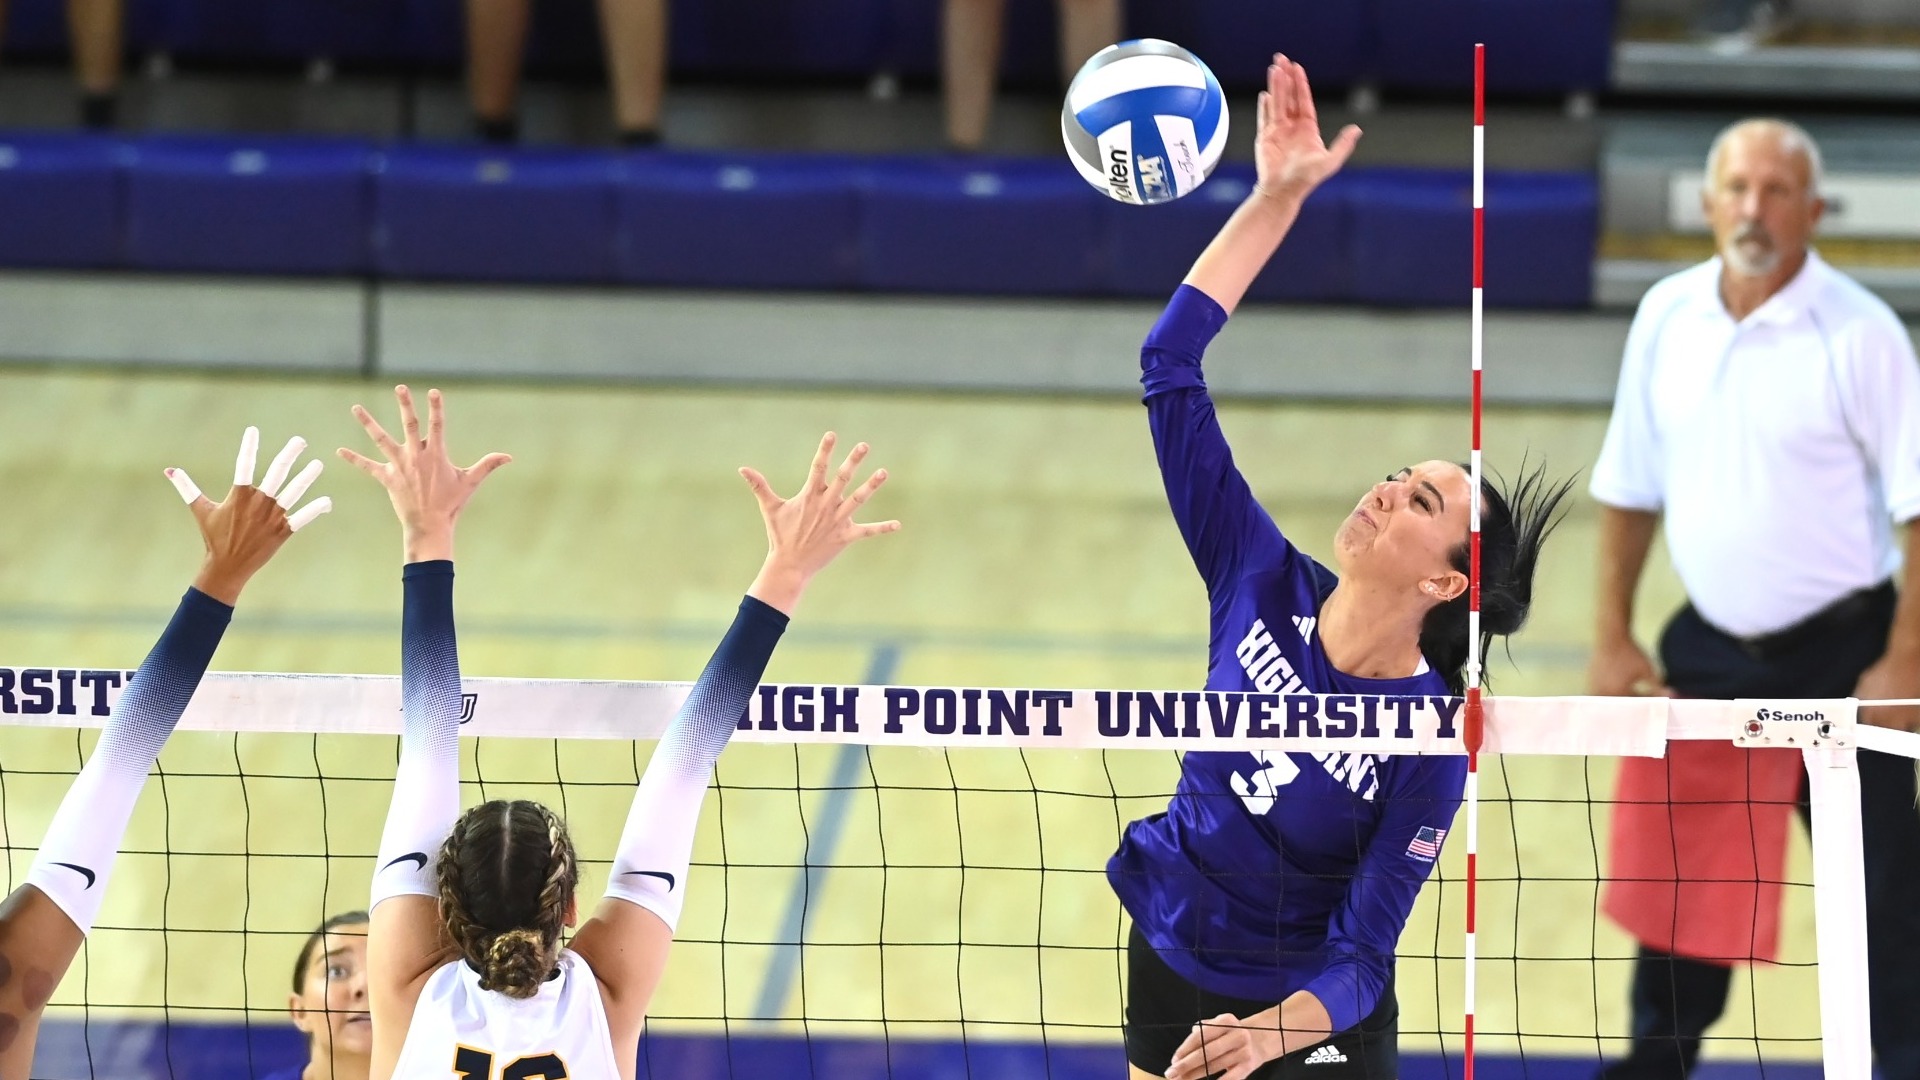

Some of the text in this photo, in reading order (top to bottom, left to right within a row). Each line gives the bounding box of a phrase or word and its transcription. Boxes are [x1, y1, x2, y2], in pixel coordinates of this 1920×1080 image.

[1109, 148, 1132, 200] olten
[1236, 618, 1312, 694] HIG
[0, 668, 138, 716] SIT
[883, 687, 1073, 736] POINT
[1095, 691, 1465, 739] UNIVERSITY
[1772, 710, 1825, 721] Senoh
[1230, 751, 1300, 816] 3
[1304, 1053, 1348, 1065] adidas
